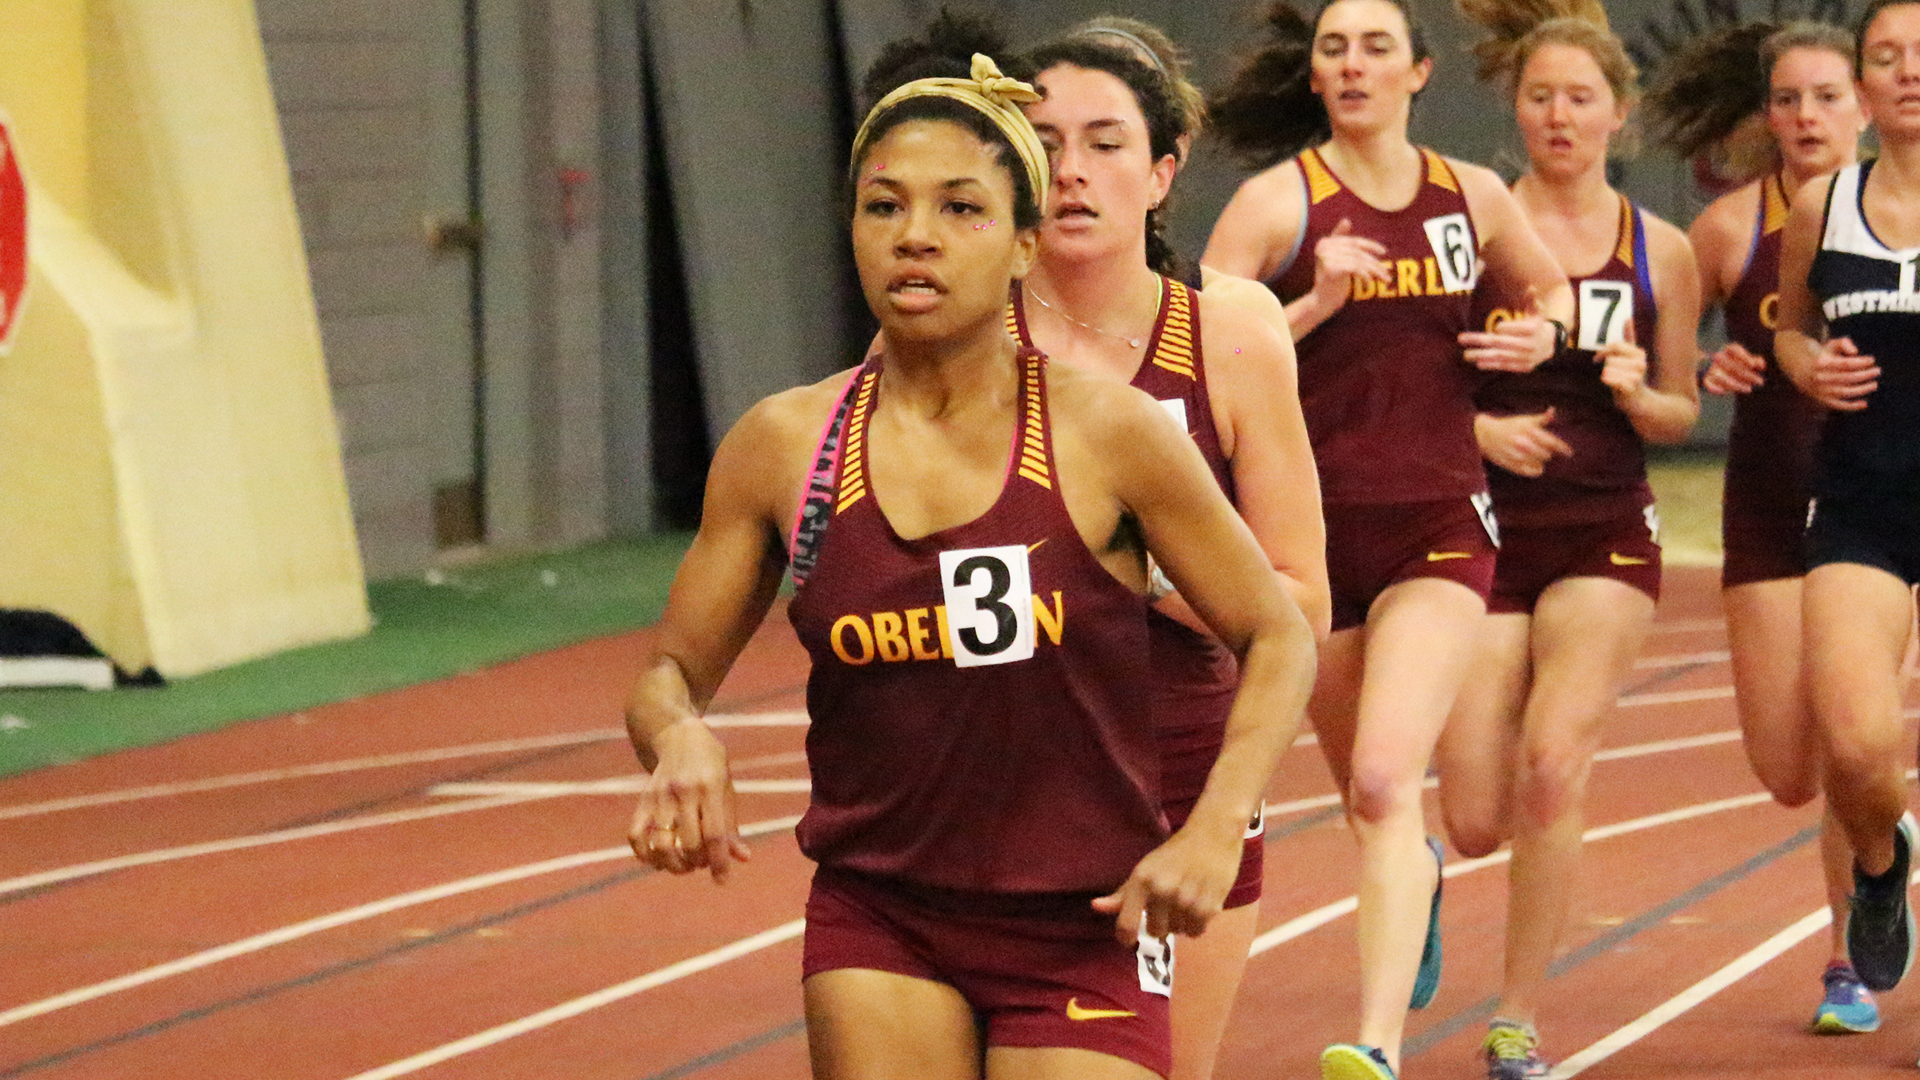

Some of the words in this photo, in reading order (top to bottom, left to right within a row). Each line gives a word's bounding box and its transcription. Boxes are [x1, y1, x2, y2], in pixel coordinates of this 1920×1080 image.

[1352, 256, 1475, 302] BERL
[1442, 222, 1470, 284] 6
[1590, 288, 1622, 346] 7
[830, 590, 1063, 666] OBEN
[953, 554, 1018, 657] 3
